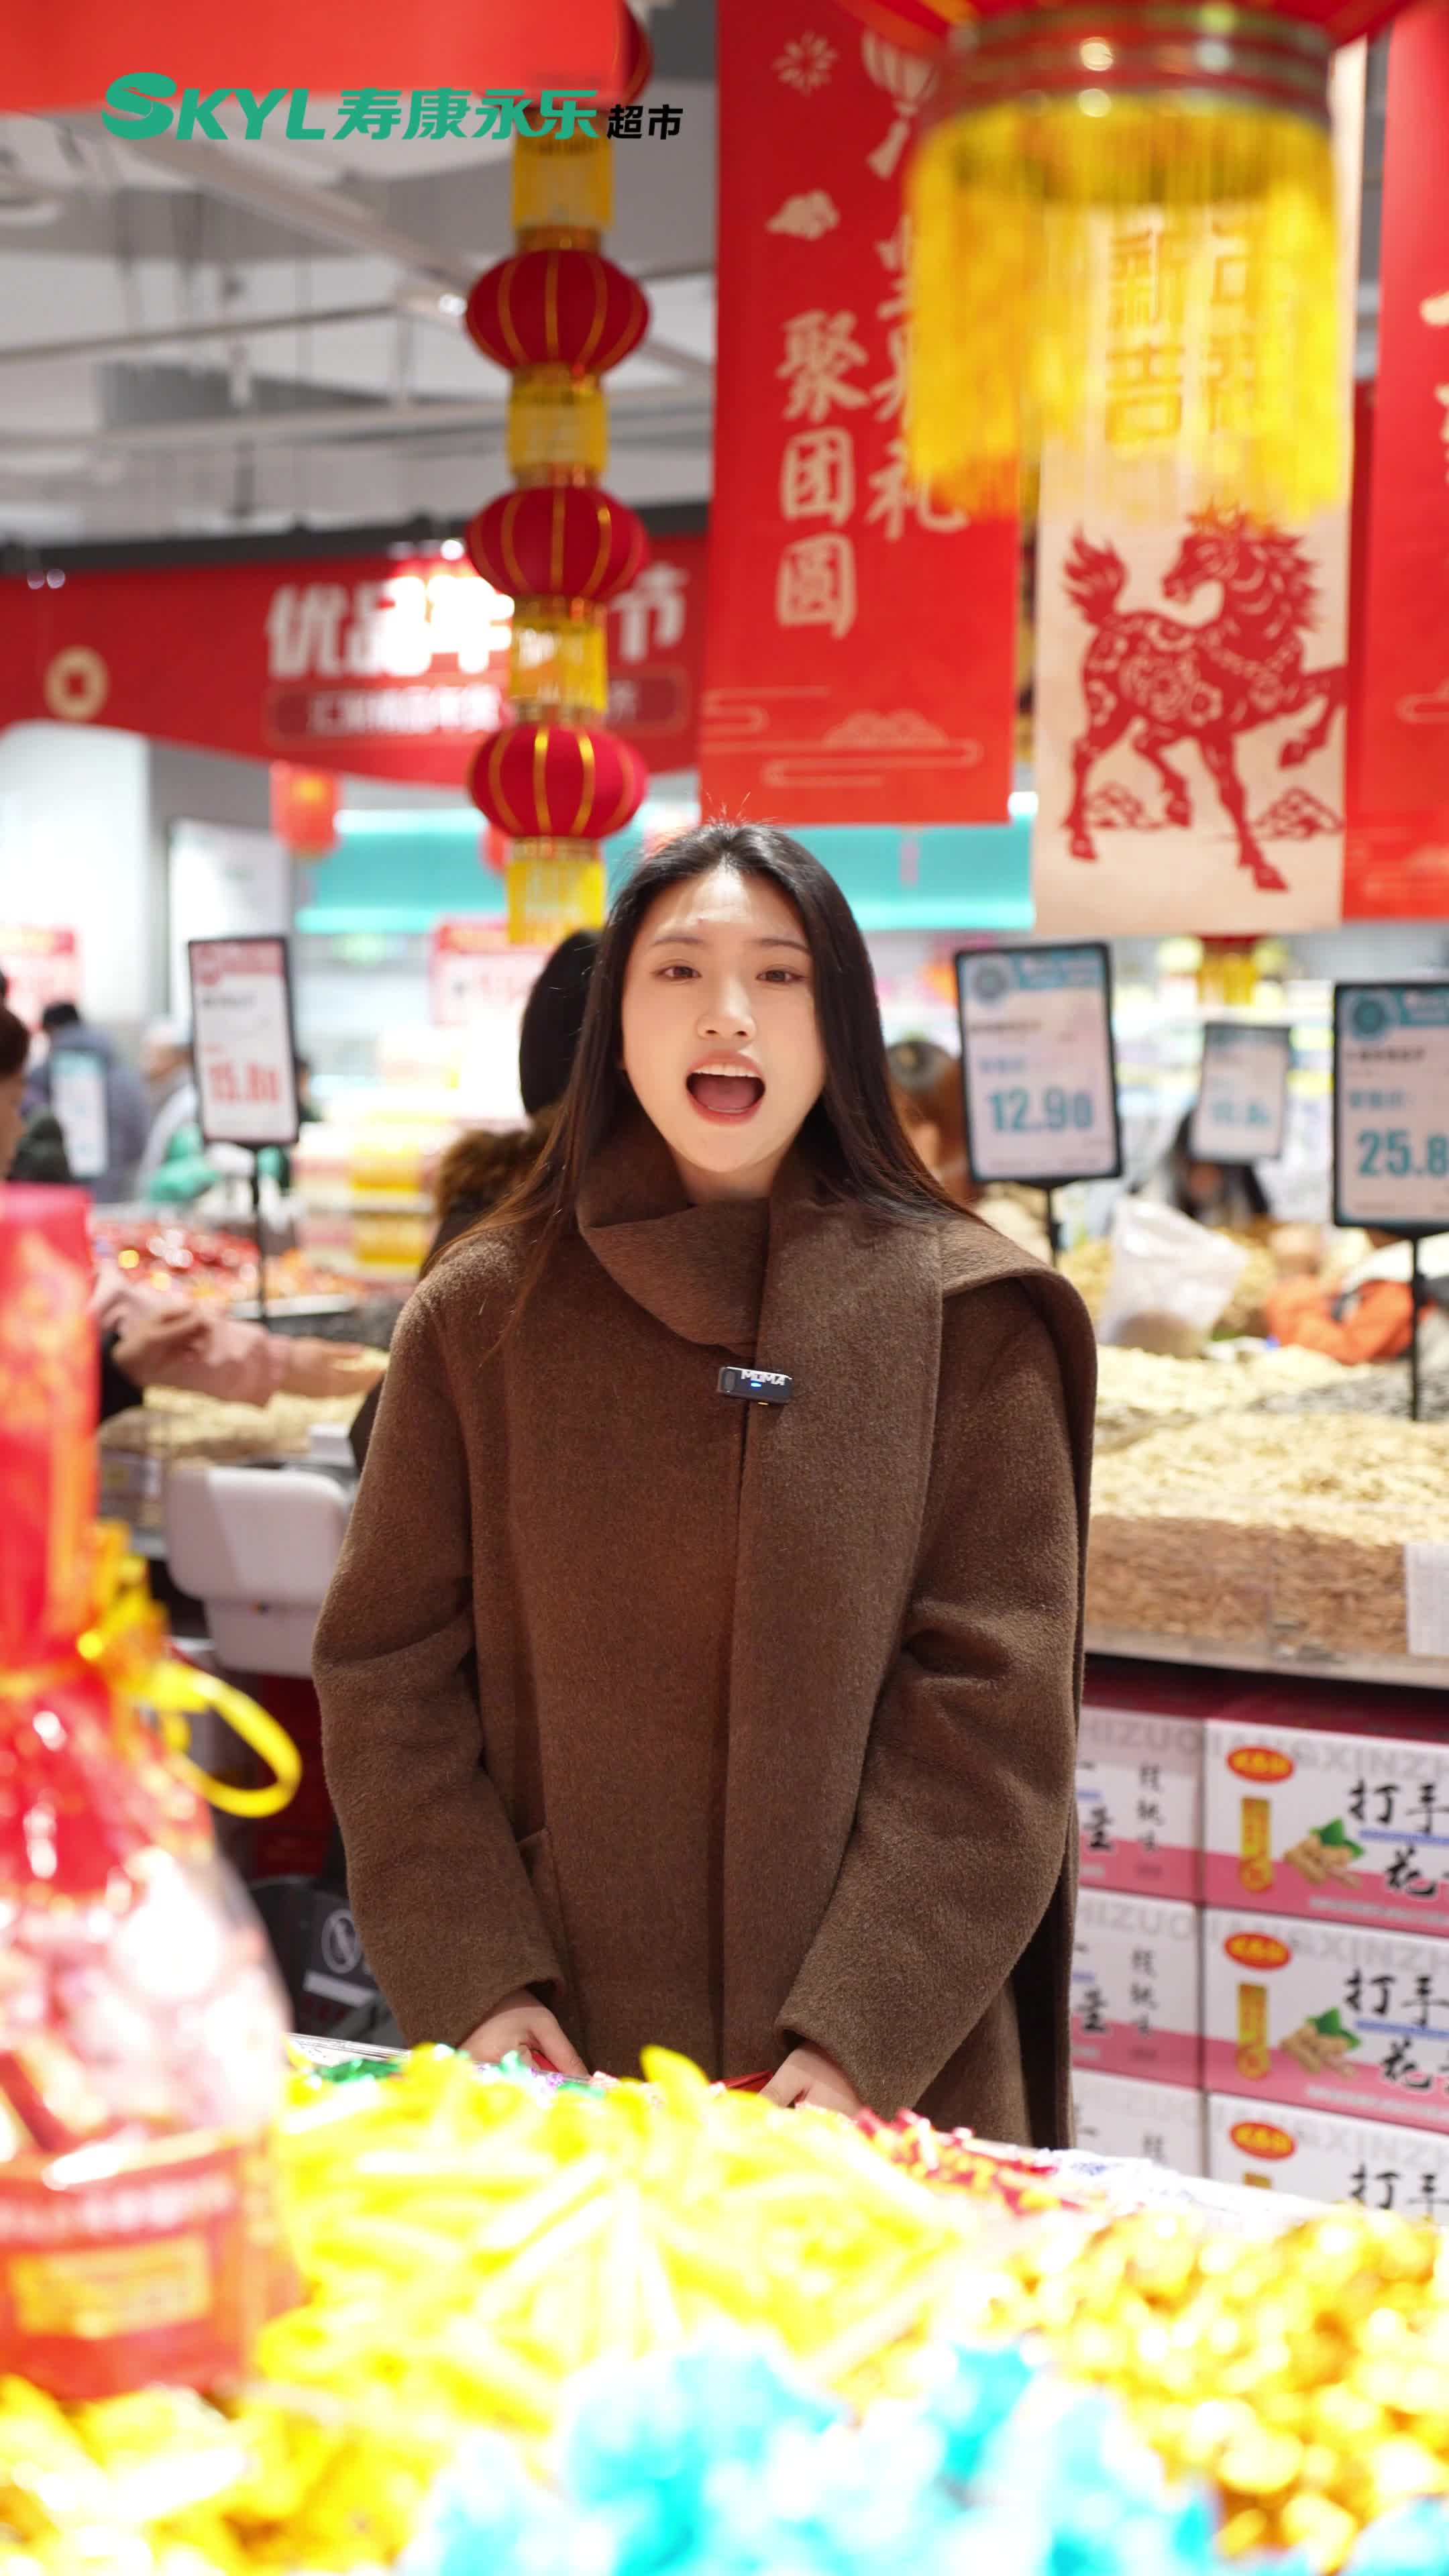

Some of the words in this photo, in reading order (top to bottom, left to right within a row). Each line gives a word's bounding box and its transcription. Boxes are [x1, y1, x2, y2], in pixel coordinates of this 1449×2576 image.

[776, 309, 870, 641] 聚团圆
[266, 561, 690, 678] 优品年节
[989, 1084, 1095, 1132] 12.90
[1348, 1779, 1449, 1835] 打手
[1344, 1969, 1449, 2029] 打手
